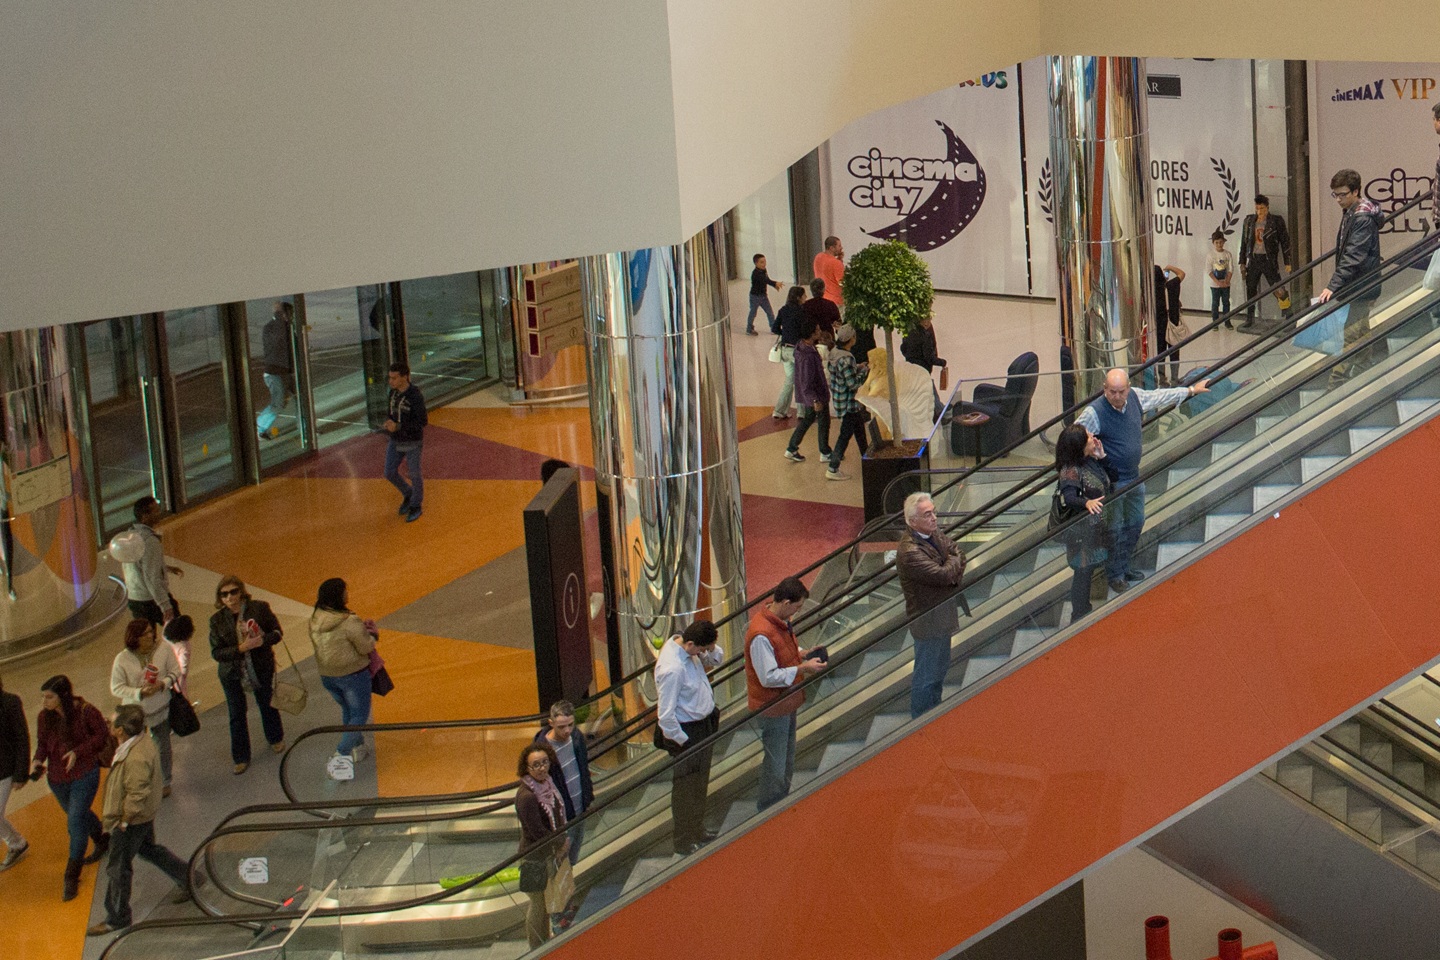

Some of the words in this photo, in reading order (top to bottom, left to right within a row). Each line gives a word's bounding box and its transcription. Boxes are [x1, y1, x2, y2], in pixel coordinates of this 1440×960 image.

[958, 71, 1008, 89] DS
[1391, 77, 1436, 99] VIP
[847, 147, 978, 182] cinema
[849, 176, 924, 216] city
[1156, 187, 1215, 211] CINEMA
[1151, 214, 1194, 237] UGAL
